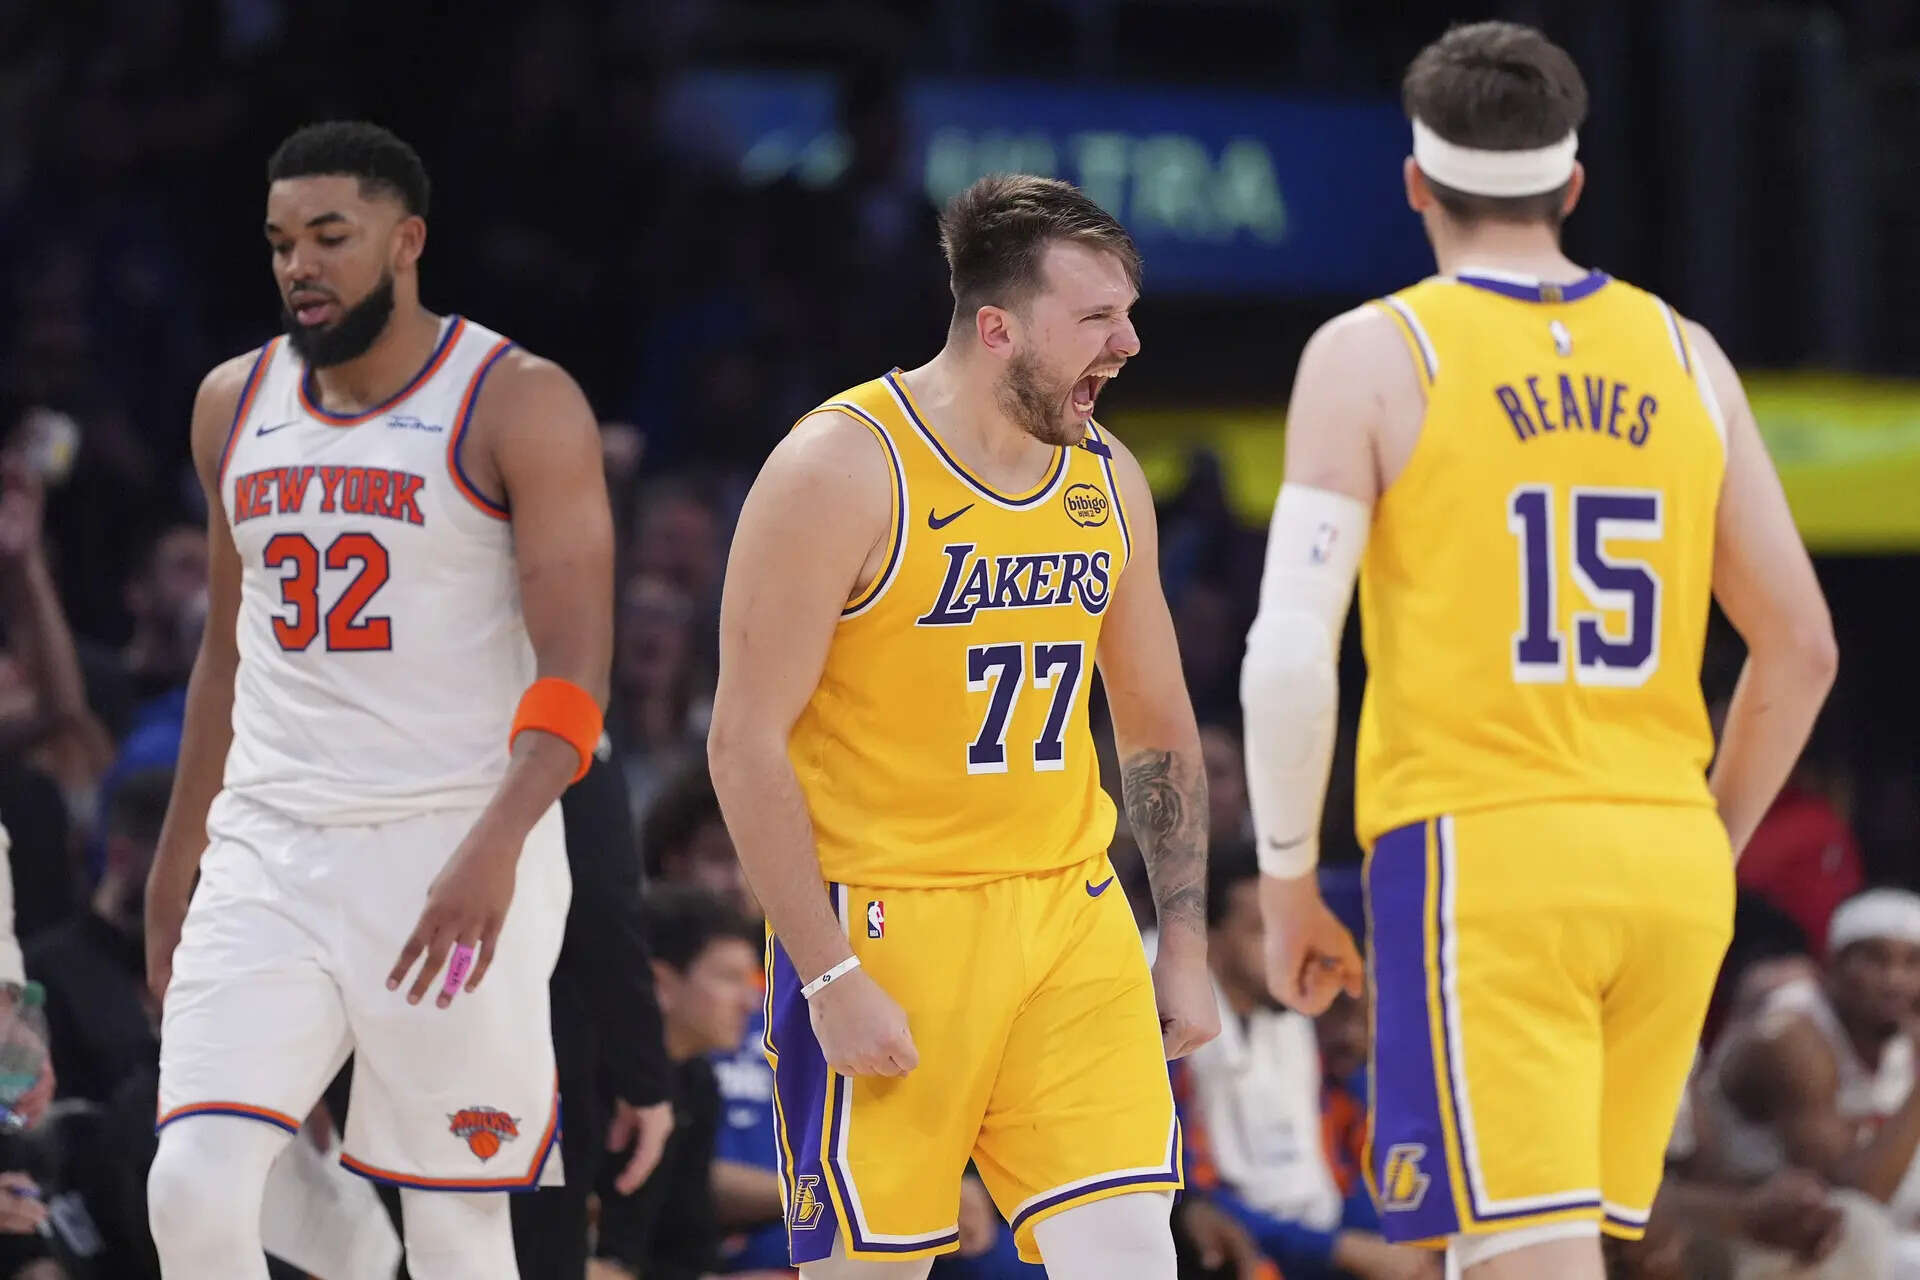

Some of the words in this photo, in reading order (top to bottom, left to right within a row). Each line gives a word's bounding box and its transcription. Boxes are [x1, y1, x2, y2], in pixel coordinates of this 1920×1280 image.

[1495, 372, 1659, 448] REAVES
[234, 465, 315, 527] NEW
[318, 465, 425, 527] YORK
[1067, 495, 1107, 514] bibigo
[262, 531, 392, 652] 32
[914, 542, 1111, 627] LAKERS
[1506, 482, 1664, 689] 15
[966, 640, 1085, 776] 77
